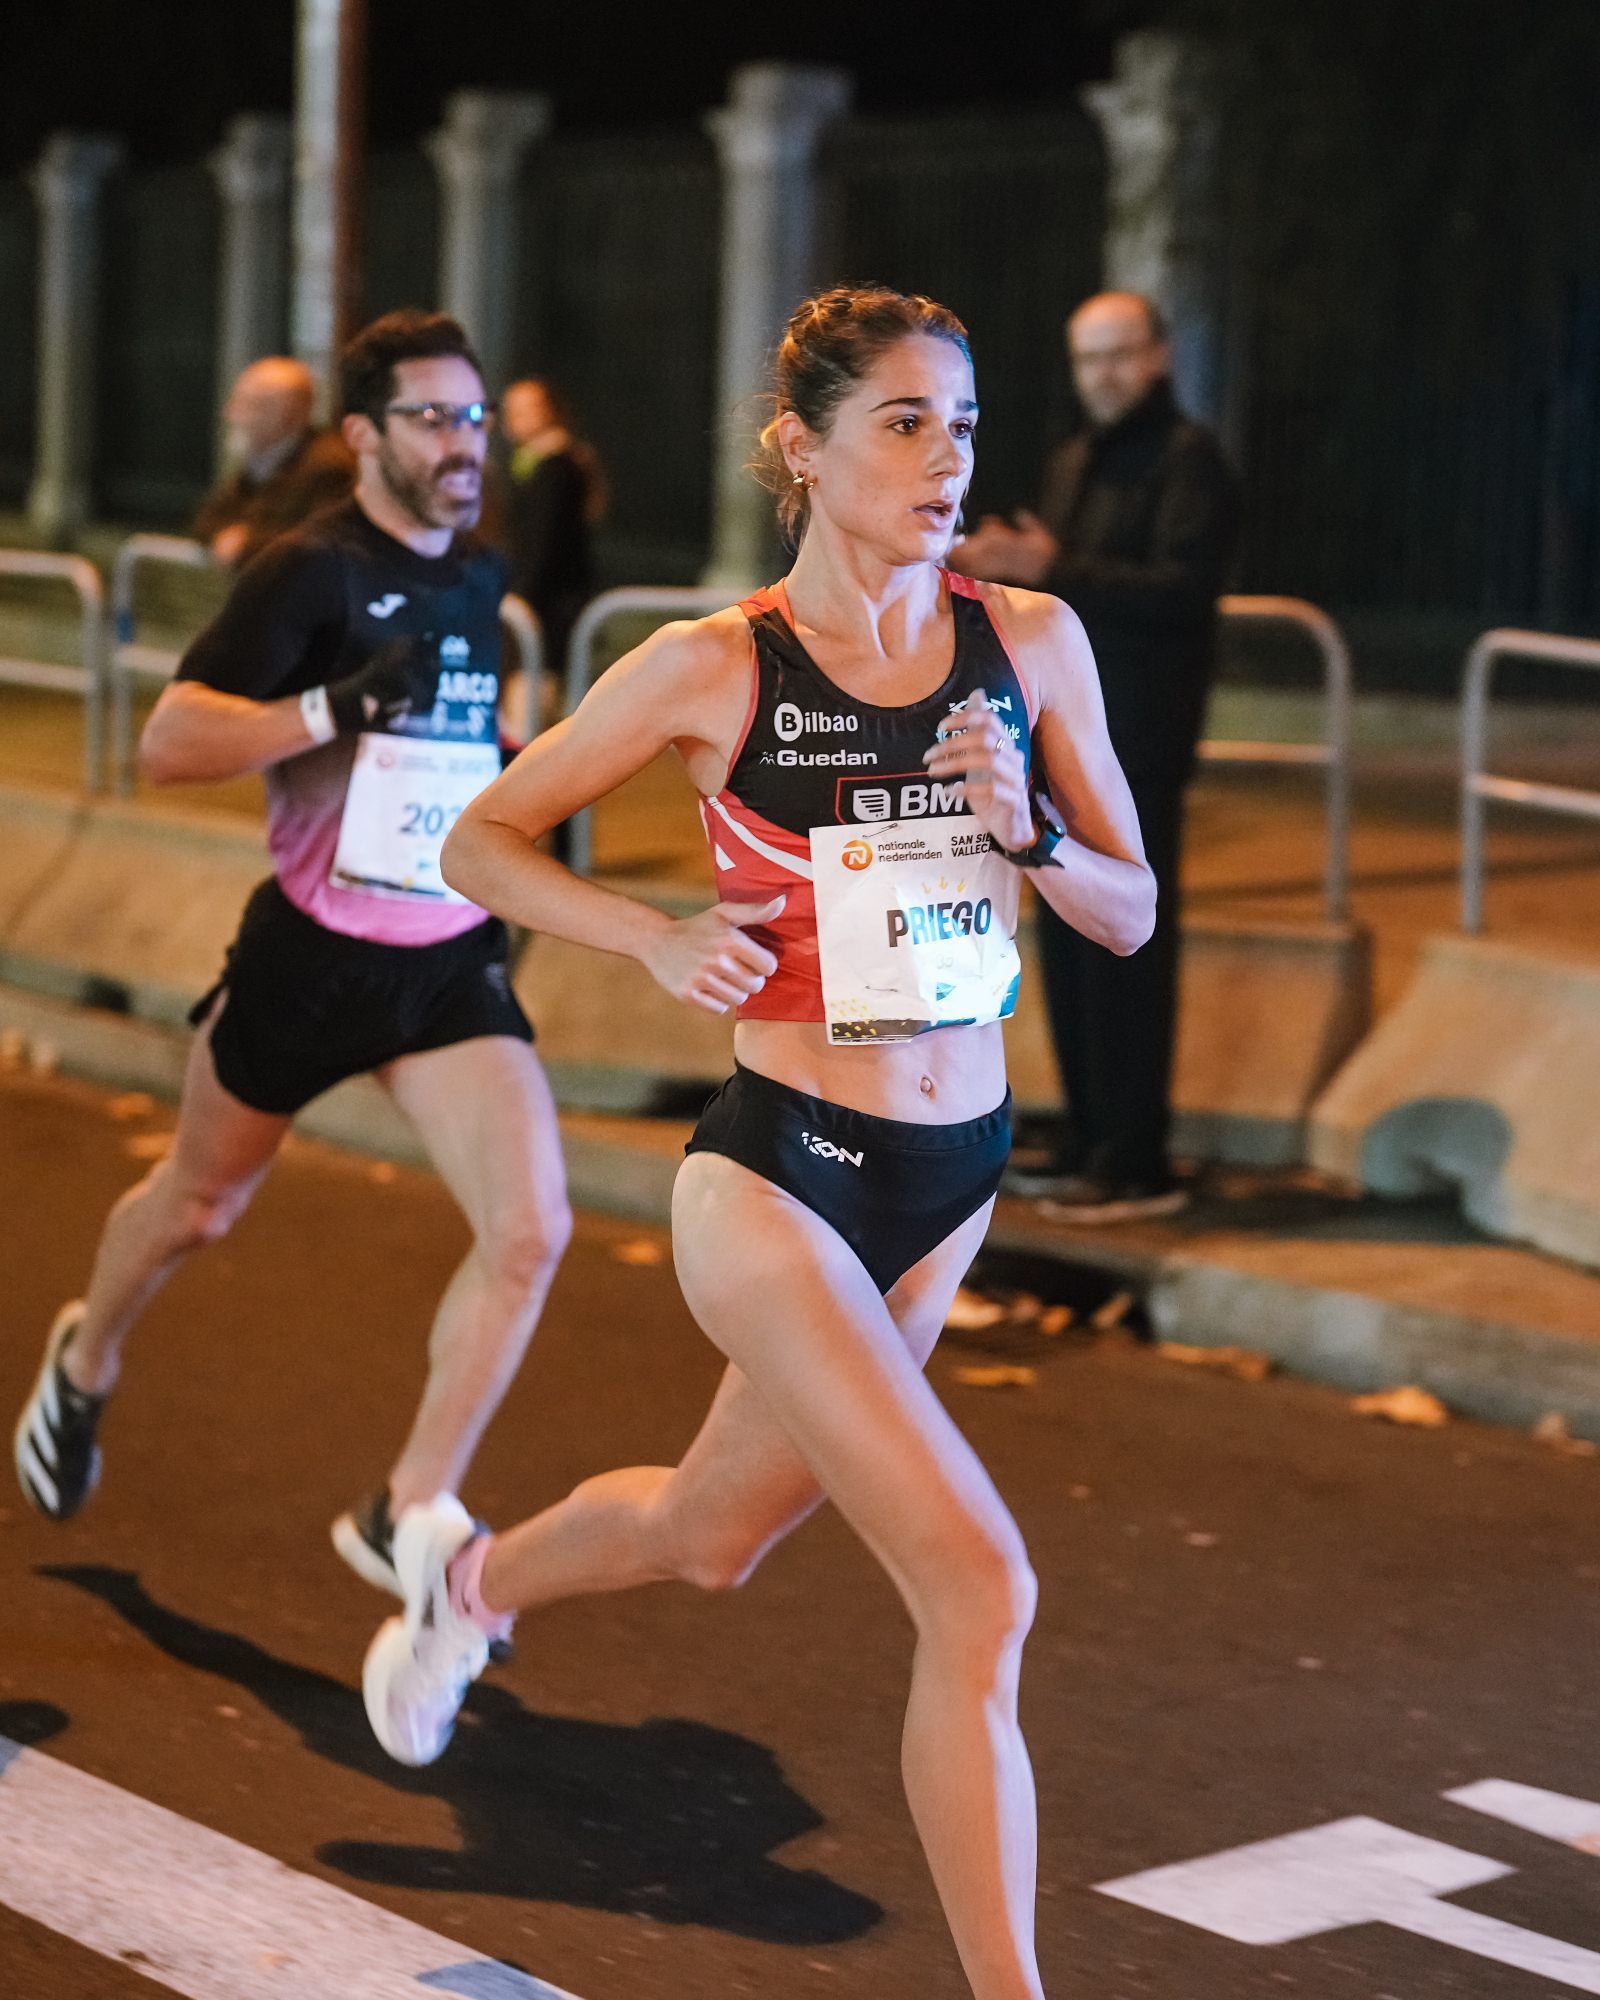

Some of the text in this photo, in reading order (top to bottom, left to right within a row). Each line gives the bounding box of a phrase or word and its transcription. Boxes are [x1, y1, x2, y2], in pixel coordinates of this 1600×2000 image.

[779, 709, 859, 735] Bilbao
[777, 749, 878, 766] Guedan
[900, 781, 965, 817] BM
[878, 839, 926, 852] nationale
[951, 835, 974, 846] SAN
[879, 850, 943, 863] nederlanden
[887, 898, 992, 948] PRIEGO
